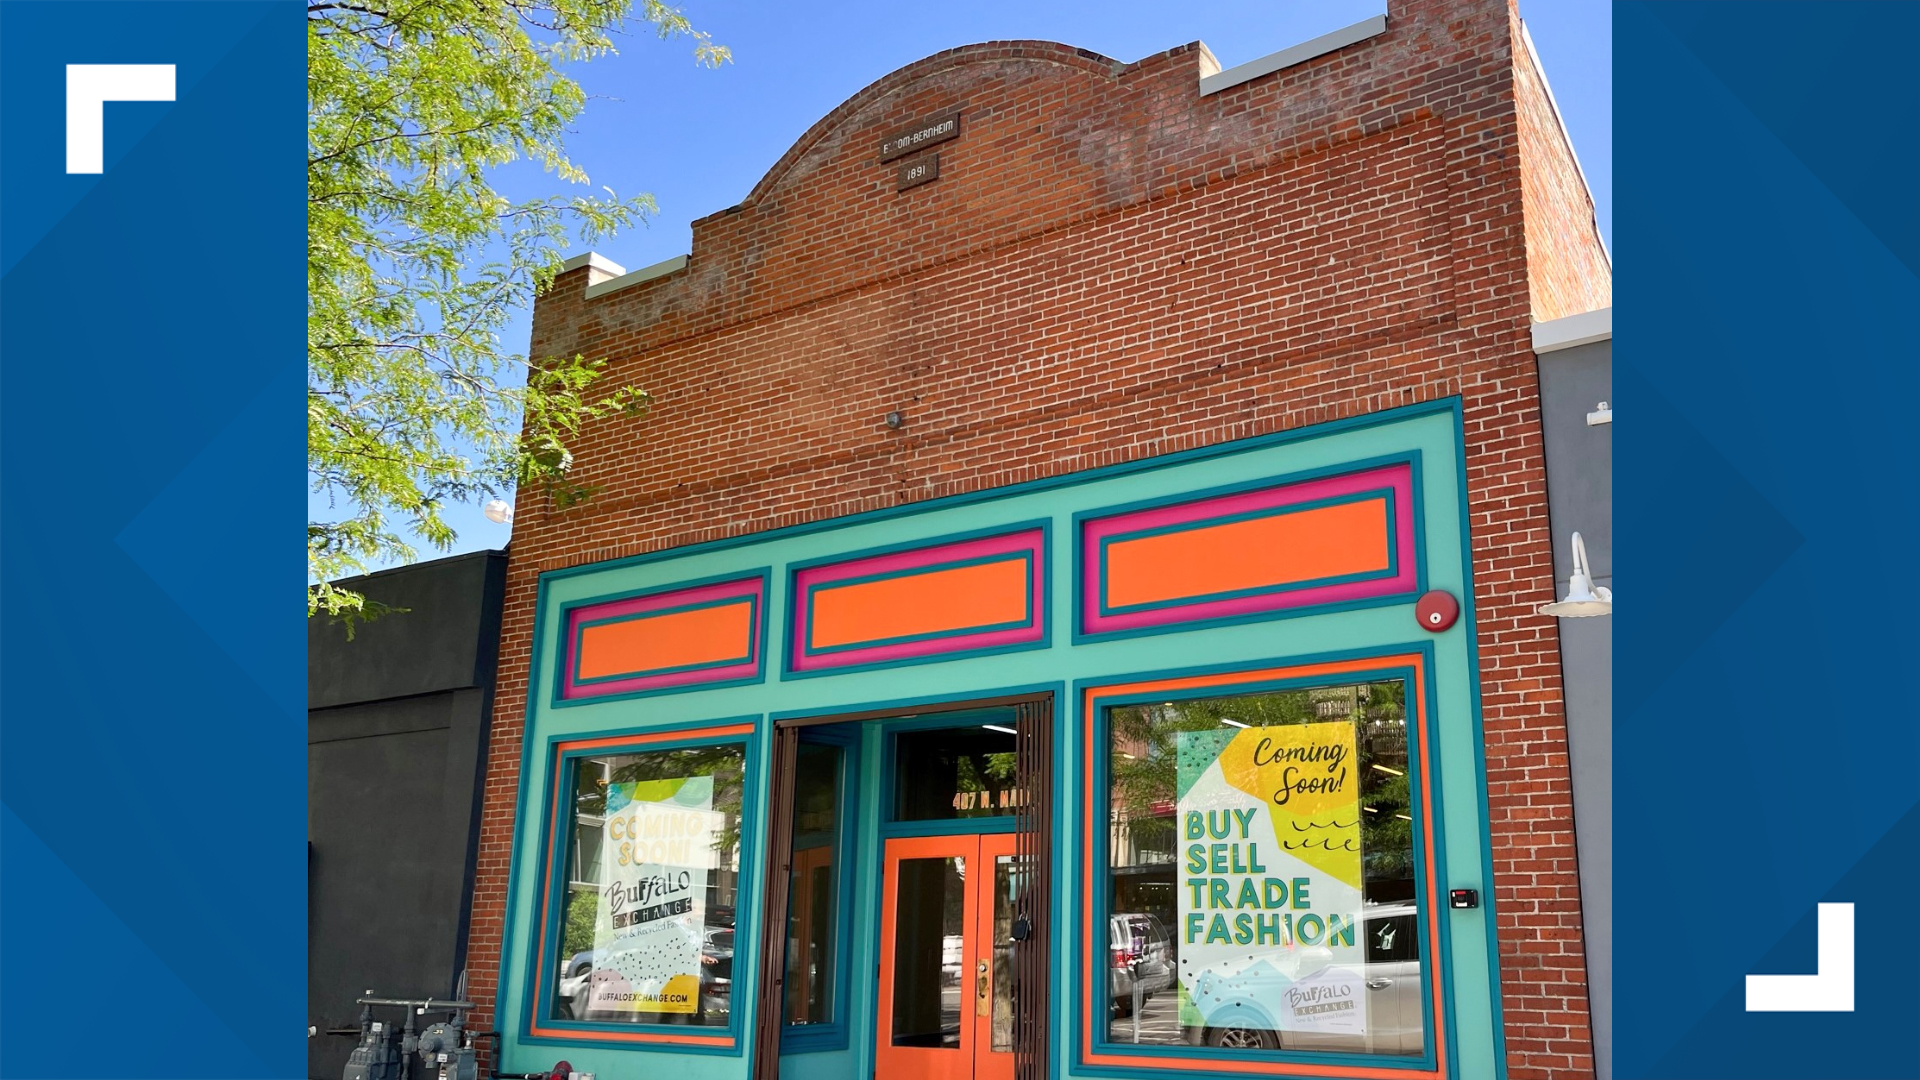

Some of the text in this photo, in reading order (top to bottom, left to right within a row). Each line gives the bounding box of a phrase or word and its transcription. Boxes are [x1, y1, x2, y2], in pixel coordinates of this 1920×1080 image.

[883, 120, 954, 154] EOM-BERNHEIM
[907, 164, 926, 180] 1891
[1253, 737, 1348, 773] Coming
[952, 792, 976, 810] 407
[980, 790, 995, 808] N.
[1273, 766, 1346, 805] Soon!
[610, 812, 703, 840] COMING
[1185, 808, 1257, 840] BUY
[1185, 843, 1266, 875] SELL
[1185, 877, 1311, 910] TRADE
[613, 898, 691, 929] EXCHANGE
[629, 929, 636, 938] &
[637, 921, 666, 936] Recycled
[1185, 913, 1355, 947] FASHION
[598, 992, 688, 1003] BUFFALOEXCHANGE.COM
[1294, 1001, 1354, 1016] EXCHANGE
